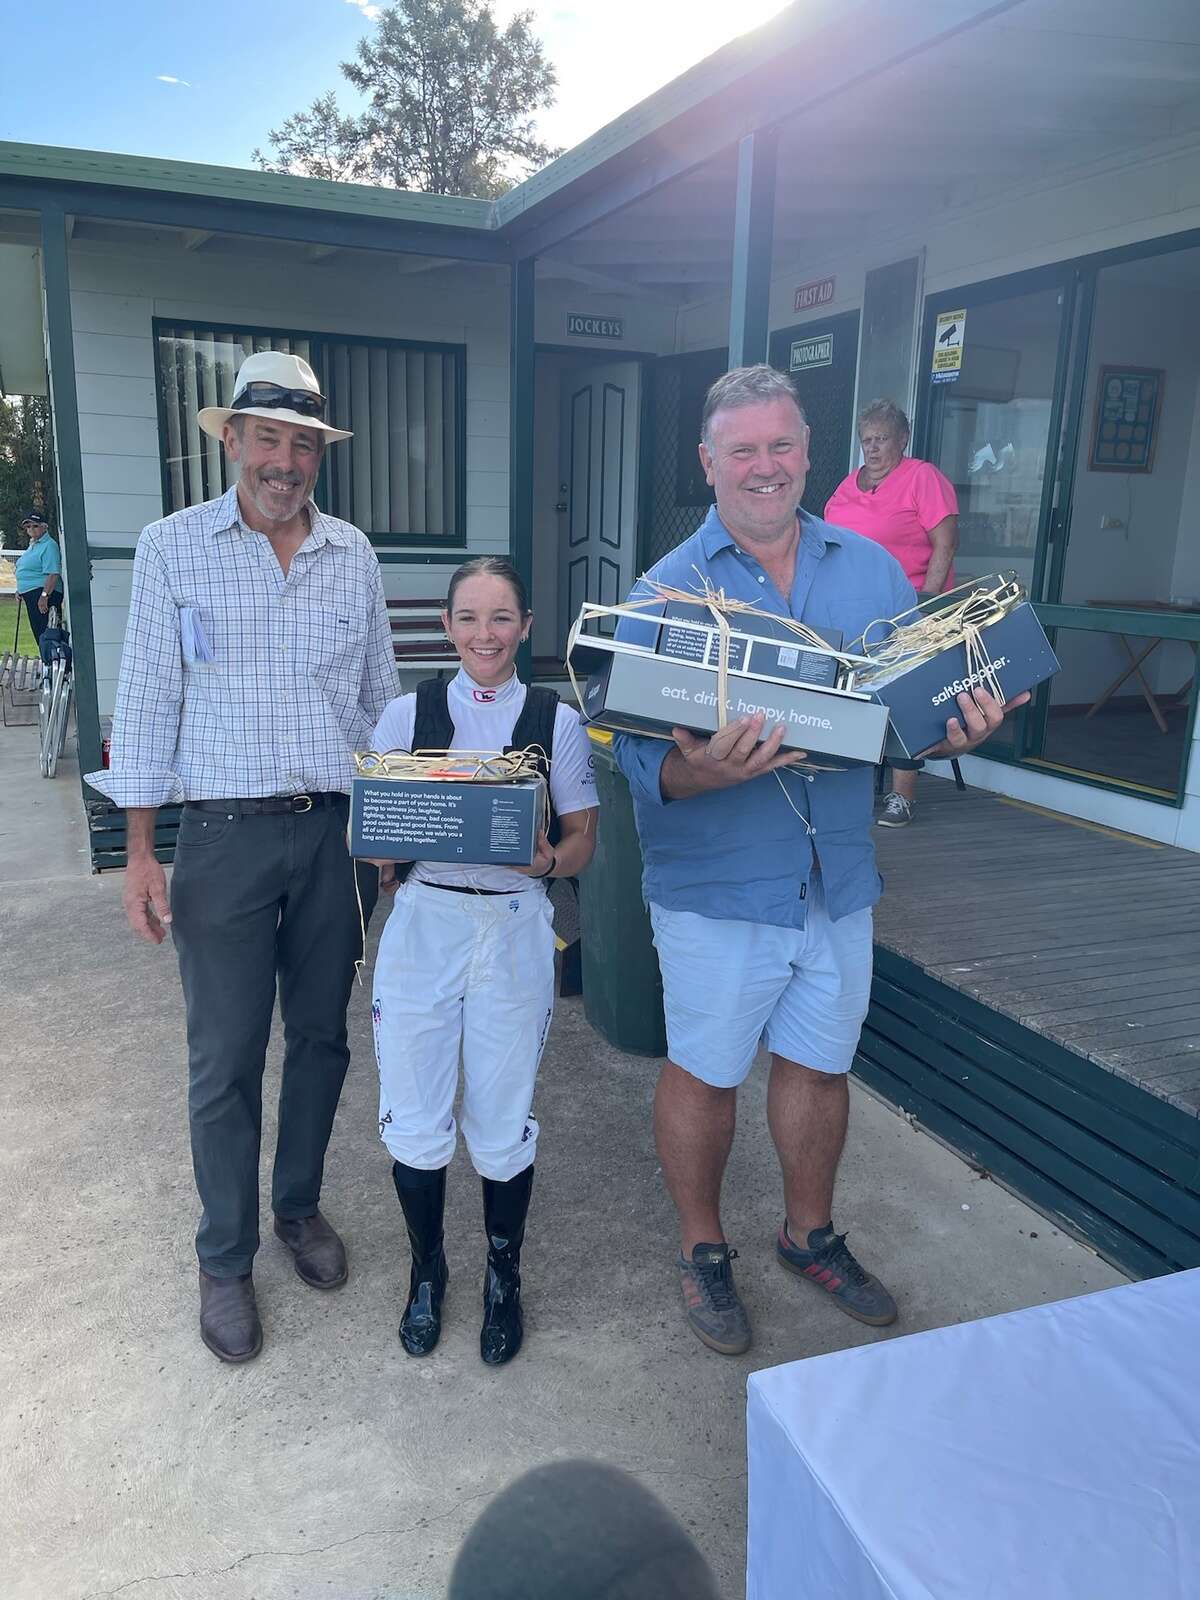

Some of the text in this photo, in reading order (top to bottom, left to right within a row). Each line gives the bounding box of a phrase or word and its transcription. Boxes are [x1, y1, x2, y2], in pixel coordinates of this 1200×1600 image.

[796, 281, 833, 309] FIRST AID
[570, 318, 620, 336] JOCKEYS
[931, 656, 1011, 706] salt&pepper.
[661, 685, 690, 701] eat.
[789, 709, 833, 730] home.
